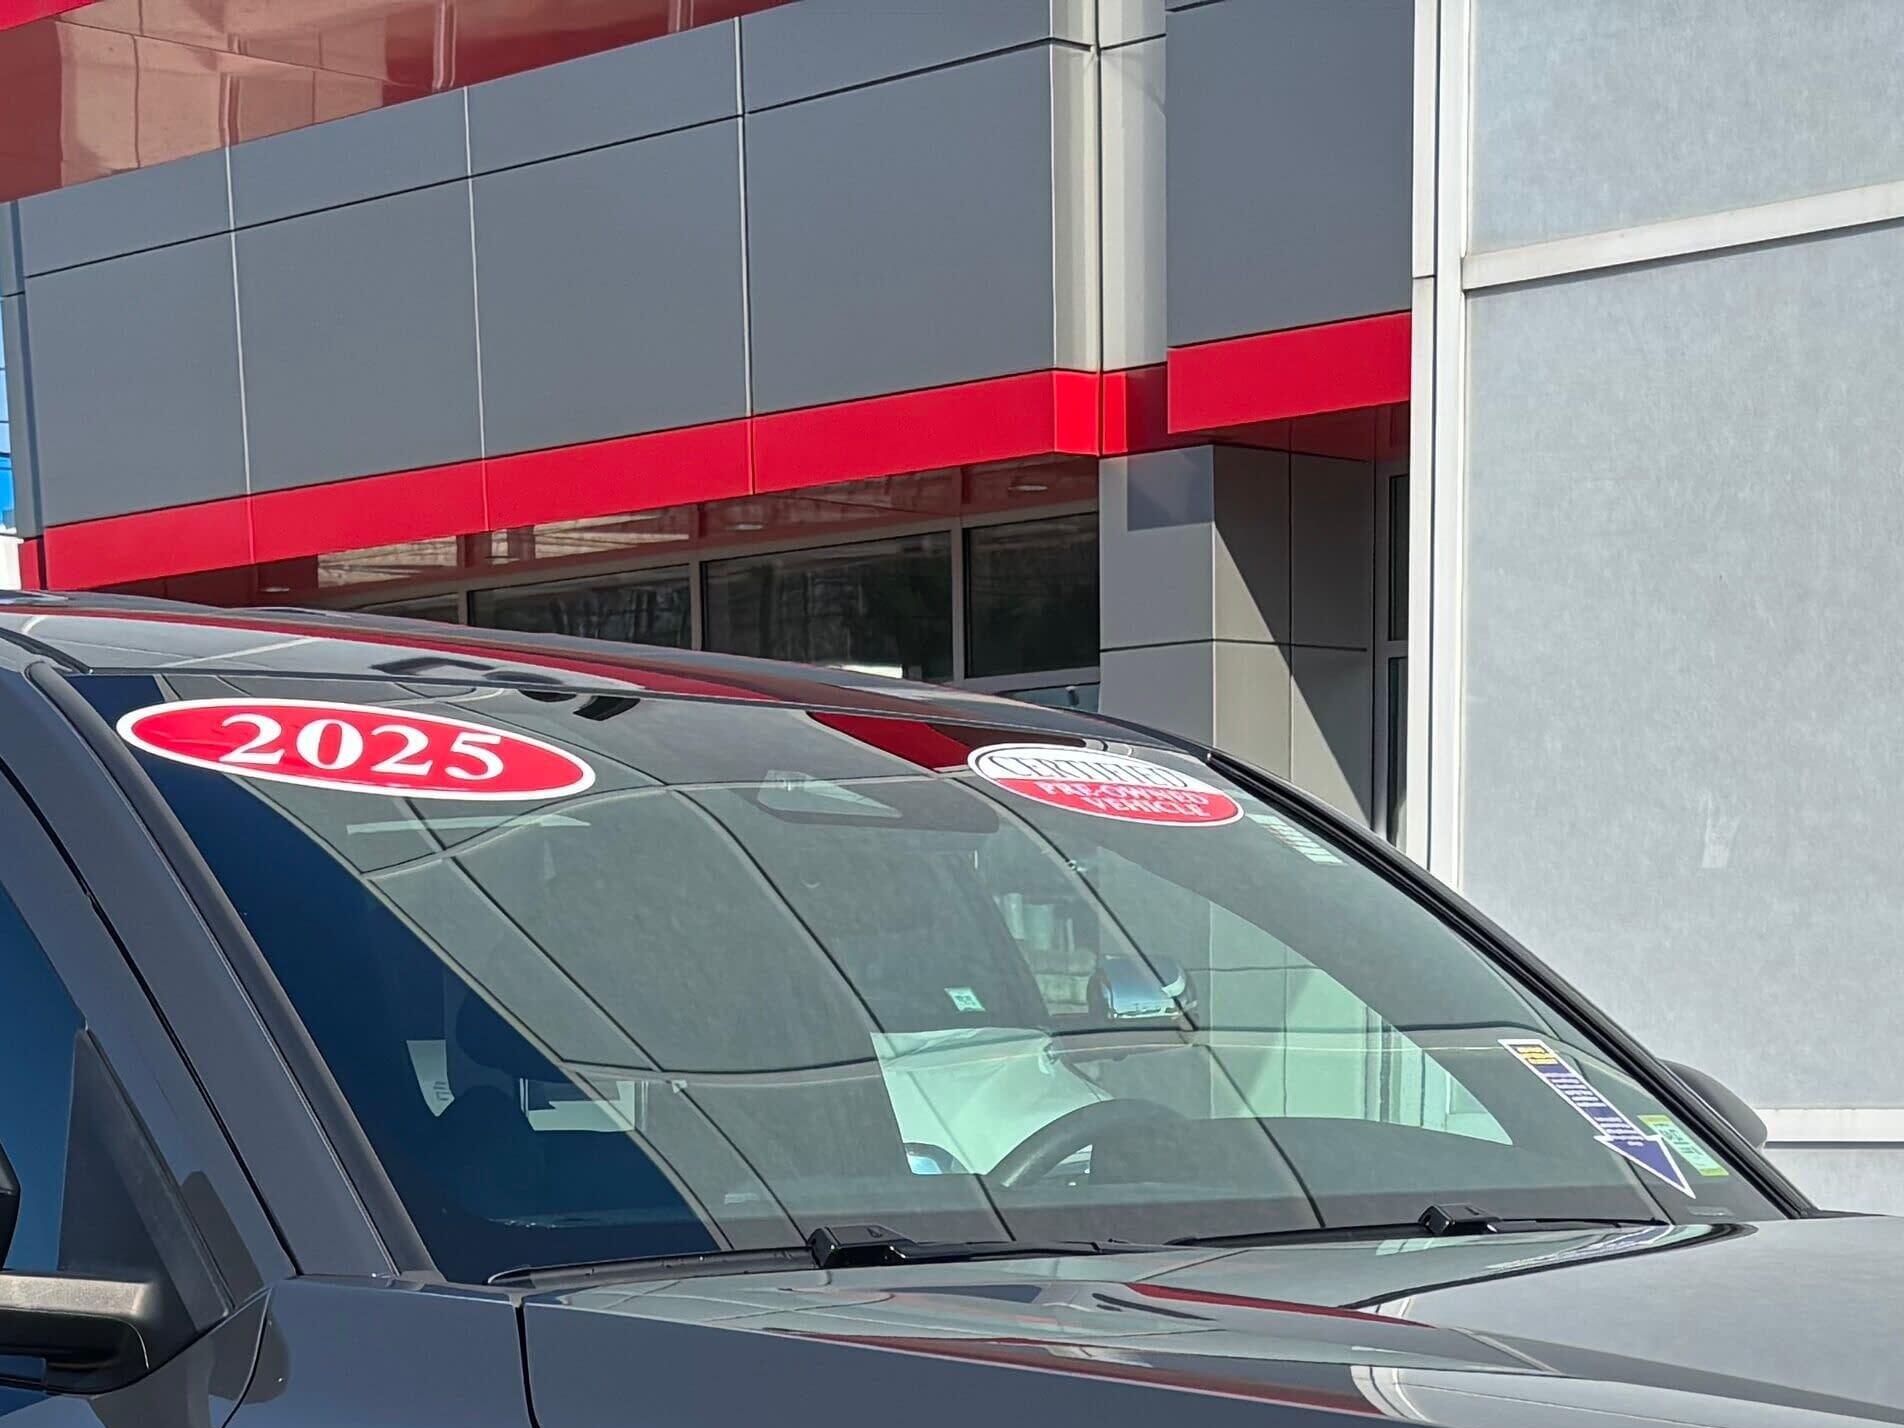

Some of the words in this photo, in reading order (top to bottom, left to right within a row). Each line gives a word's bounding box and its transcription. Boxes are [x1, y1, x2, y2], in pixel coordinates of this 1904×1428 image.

[219, 714, 504, 780] 2025
[989, 756, 1187, 787] CERTIFIED
[1035, 781, 1209, 805] PRE-OWNED
[1083, 798, 1210, 817] VEHICLE
